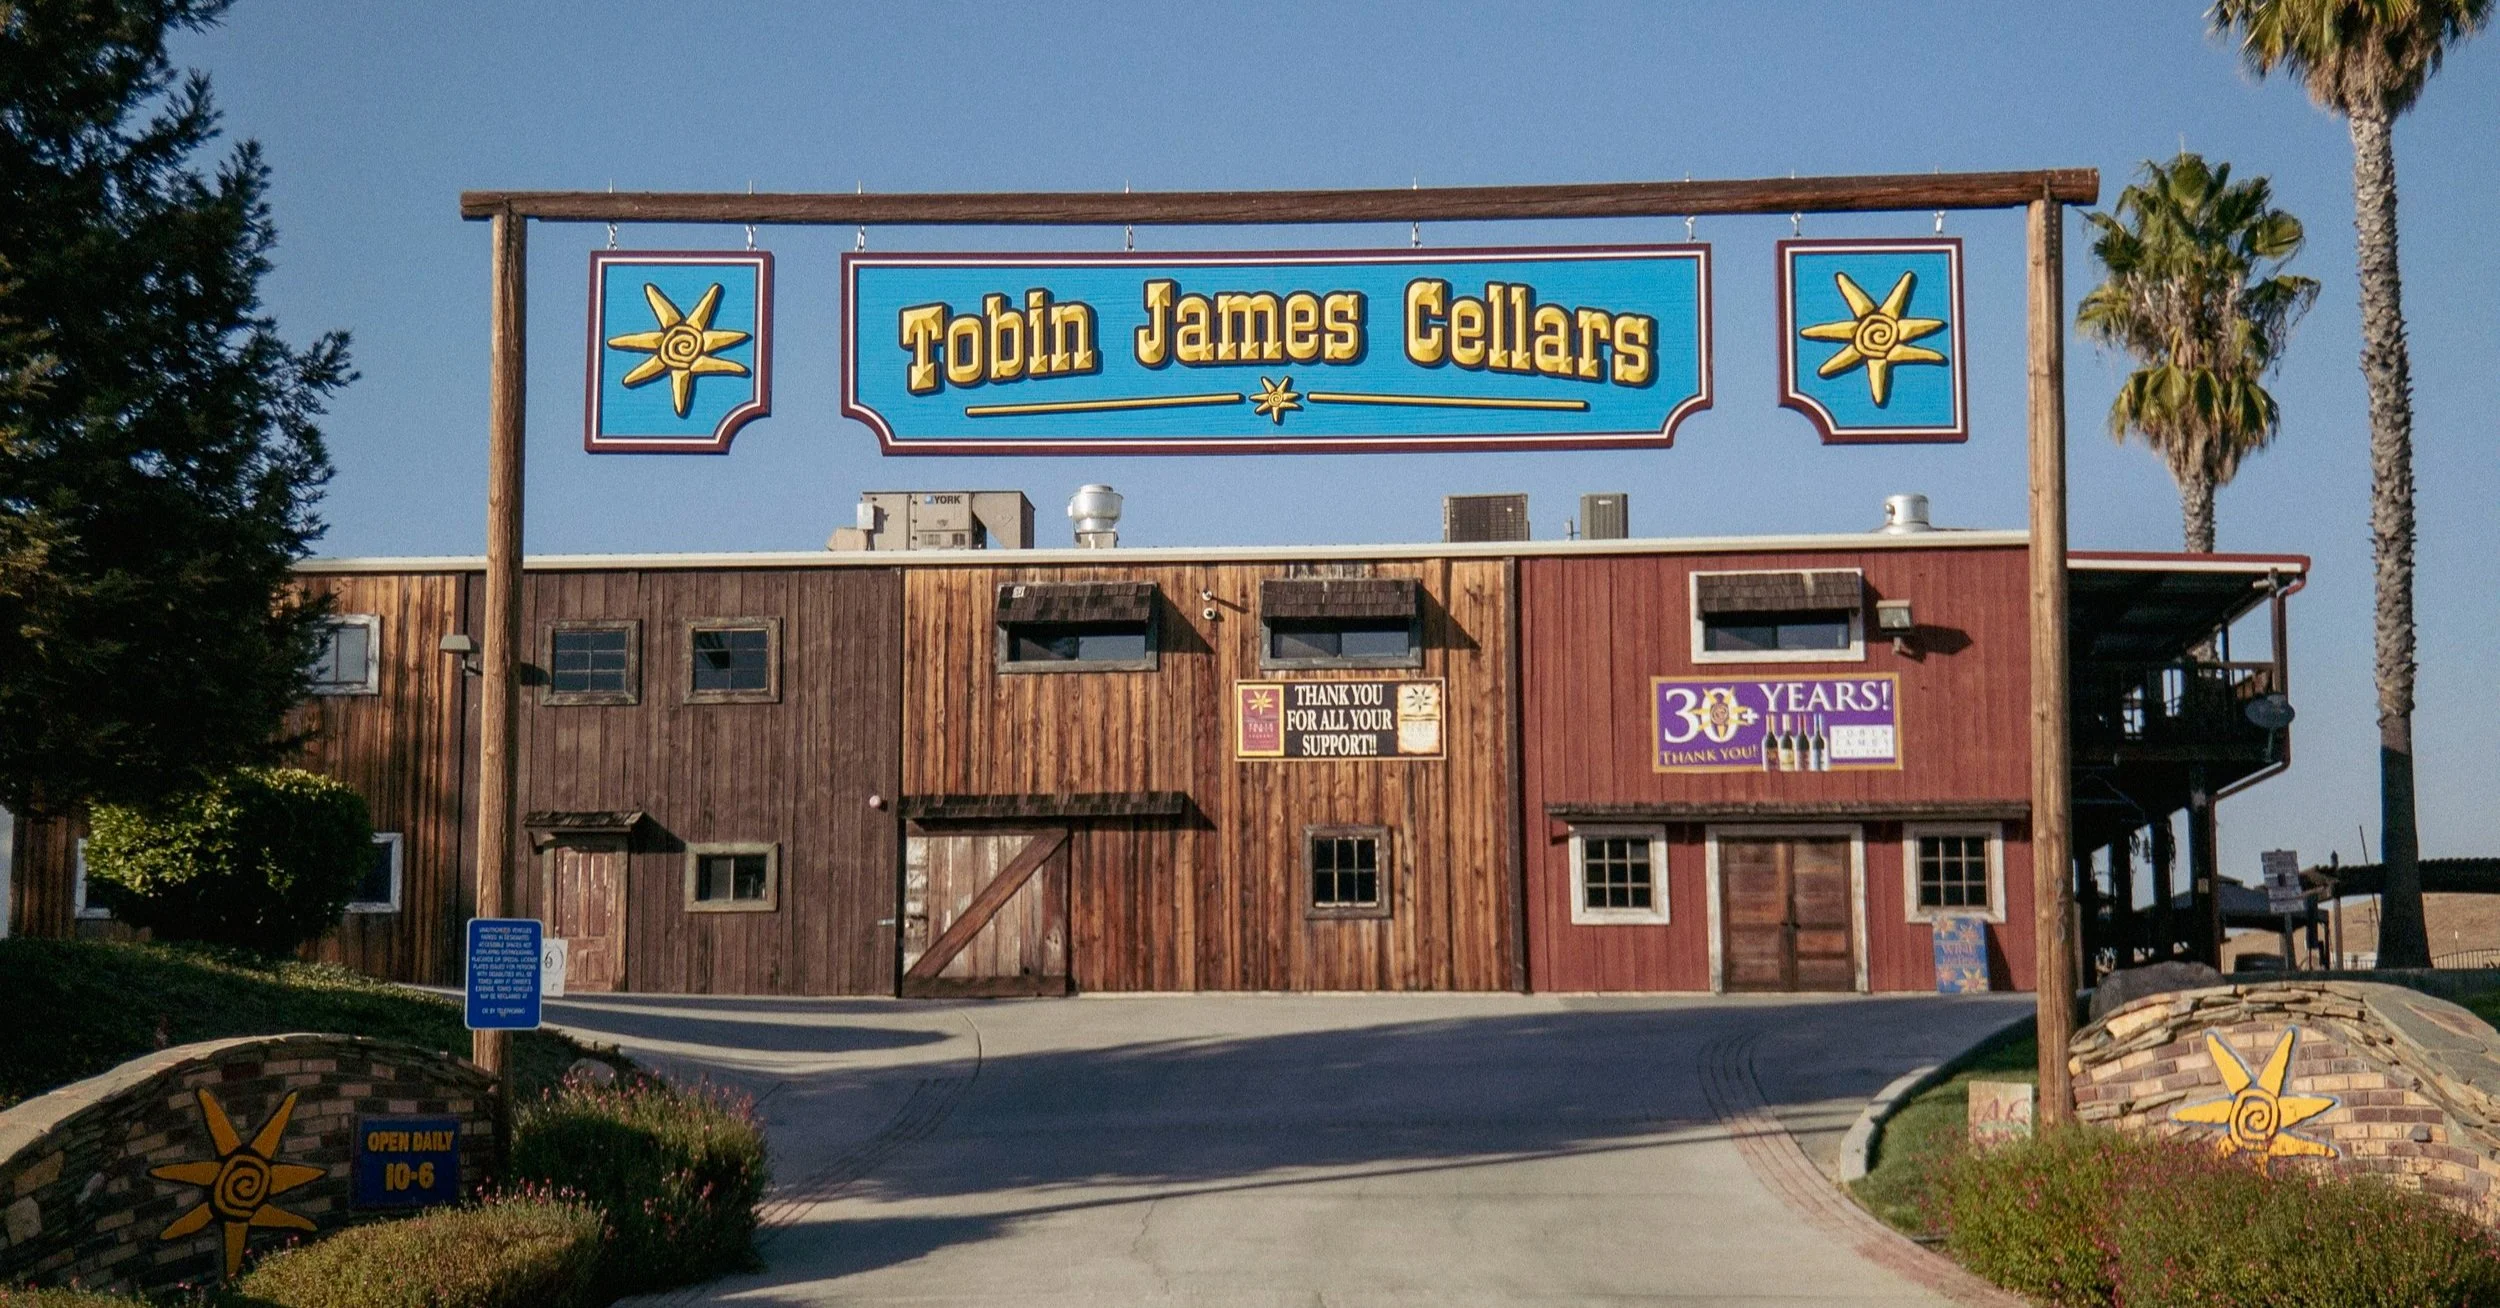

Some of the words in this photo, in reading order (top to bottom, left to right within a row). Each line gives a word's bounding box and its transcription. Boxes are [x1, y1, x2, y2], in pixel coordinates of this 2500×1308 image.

[900, 288, 1096, 393] Tobin
[1136, 280, 1362, 366] James
[1405, 279, 1653, 386] Cellars
[934, 495, 960, 504] YORK
[1295, 684, 1349, 706] THANK
[1350, 684, 1383, 706] YOU
[1758, 681, 1892, 712] YEARS!
[1287, 709, 1318, 731] FOR
[1320, 709, 1350, 731] ALL
[1350, 709, 1393, 730] YOUR
[1302, 734, 1377, 756] SUPPORT!!
[1661, 749, 1717, 765] THANK
[1719, 745, 1758, 761] YOU!
[367, 1131, 410, 1152] OPEN
[412, 1130, 455, 1152] DAILY
[385, 1162, 435, 1191] 10-6
